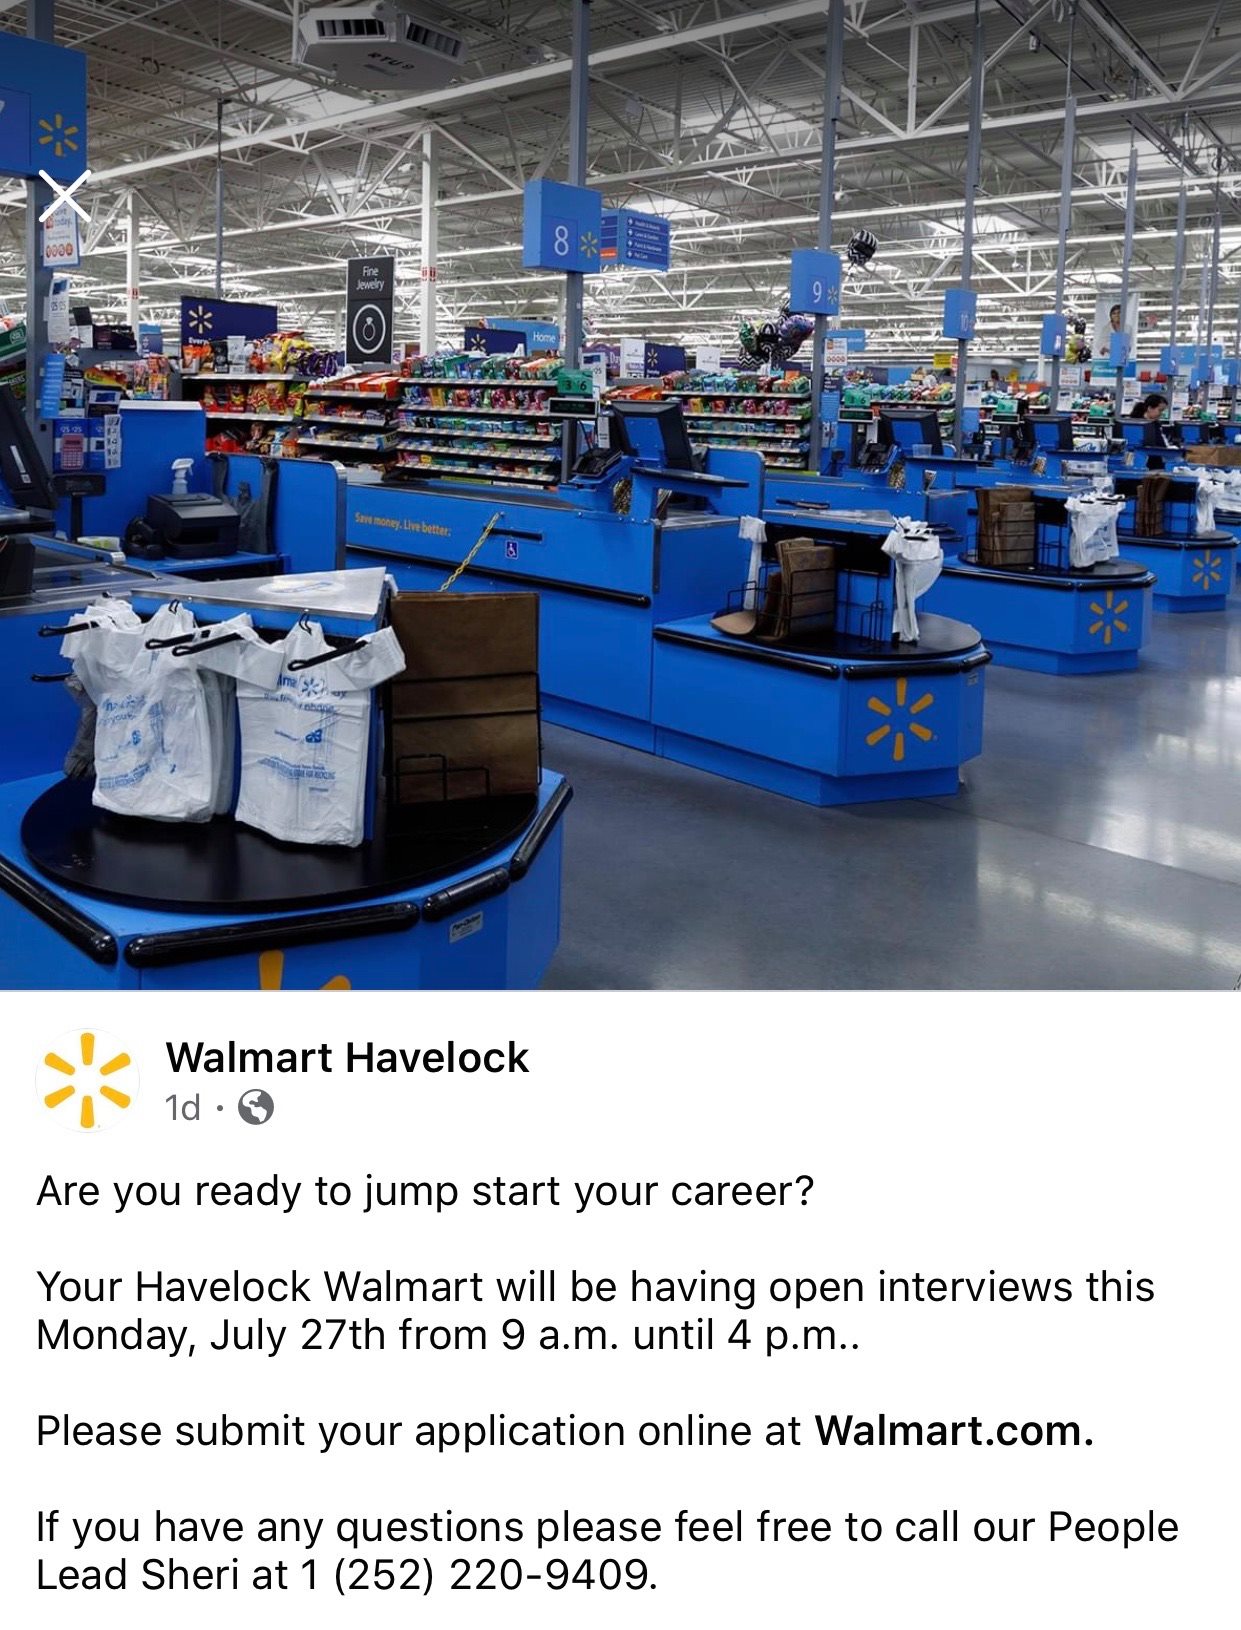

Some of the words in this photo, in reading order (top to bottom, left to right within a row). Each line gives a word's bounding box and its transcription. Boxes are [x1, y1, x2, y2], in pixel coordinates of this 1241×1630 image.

[554, 225, 569, 256] 8
[363, 265, 379, 277] Fine
[356, 278, 385, 292] Jewelry
[812, 281, 822, 303] 9
[533, 331, 556, 343] Home
[355, 511, 372, 525] Save
[373, 516, 402, 531] money.
[404, 518, 420, 532] Live
